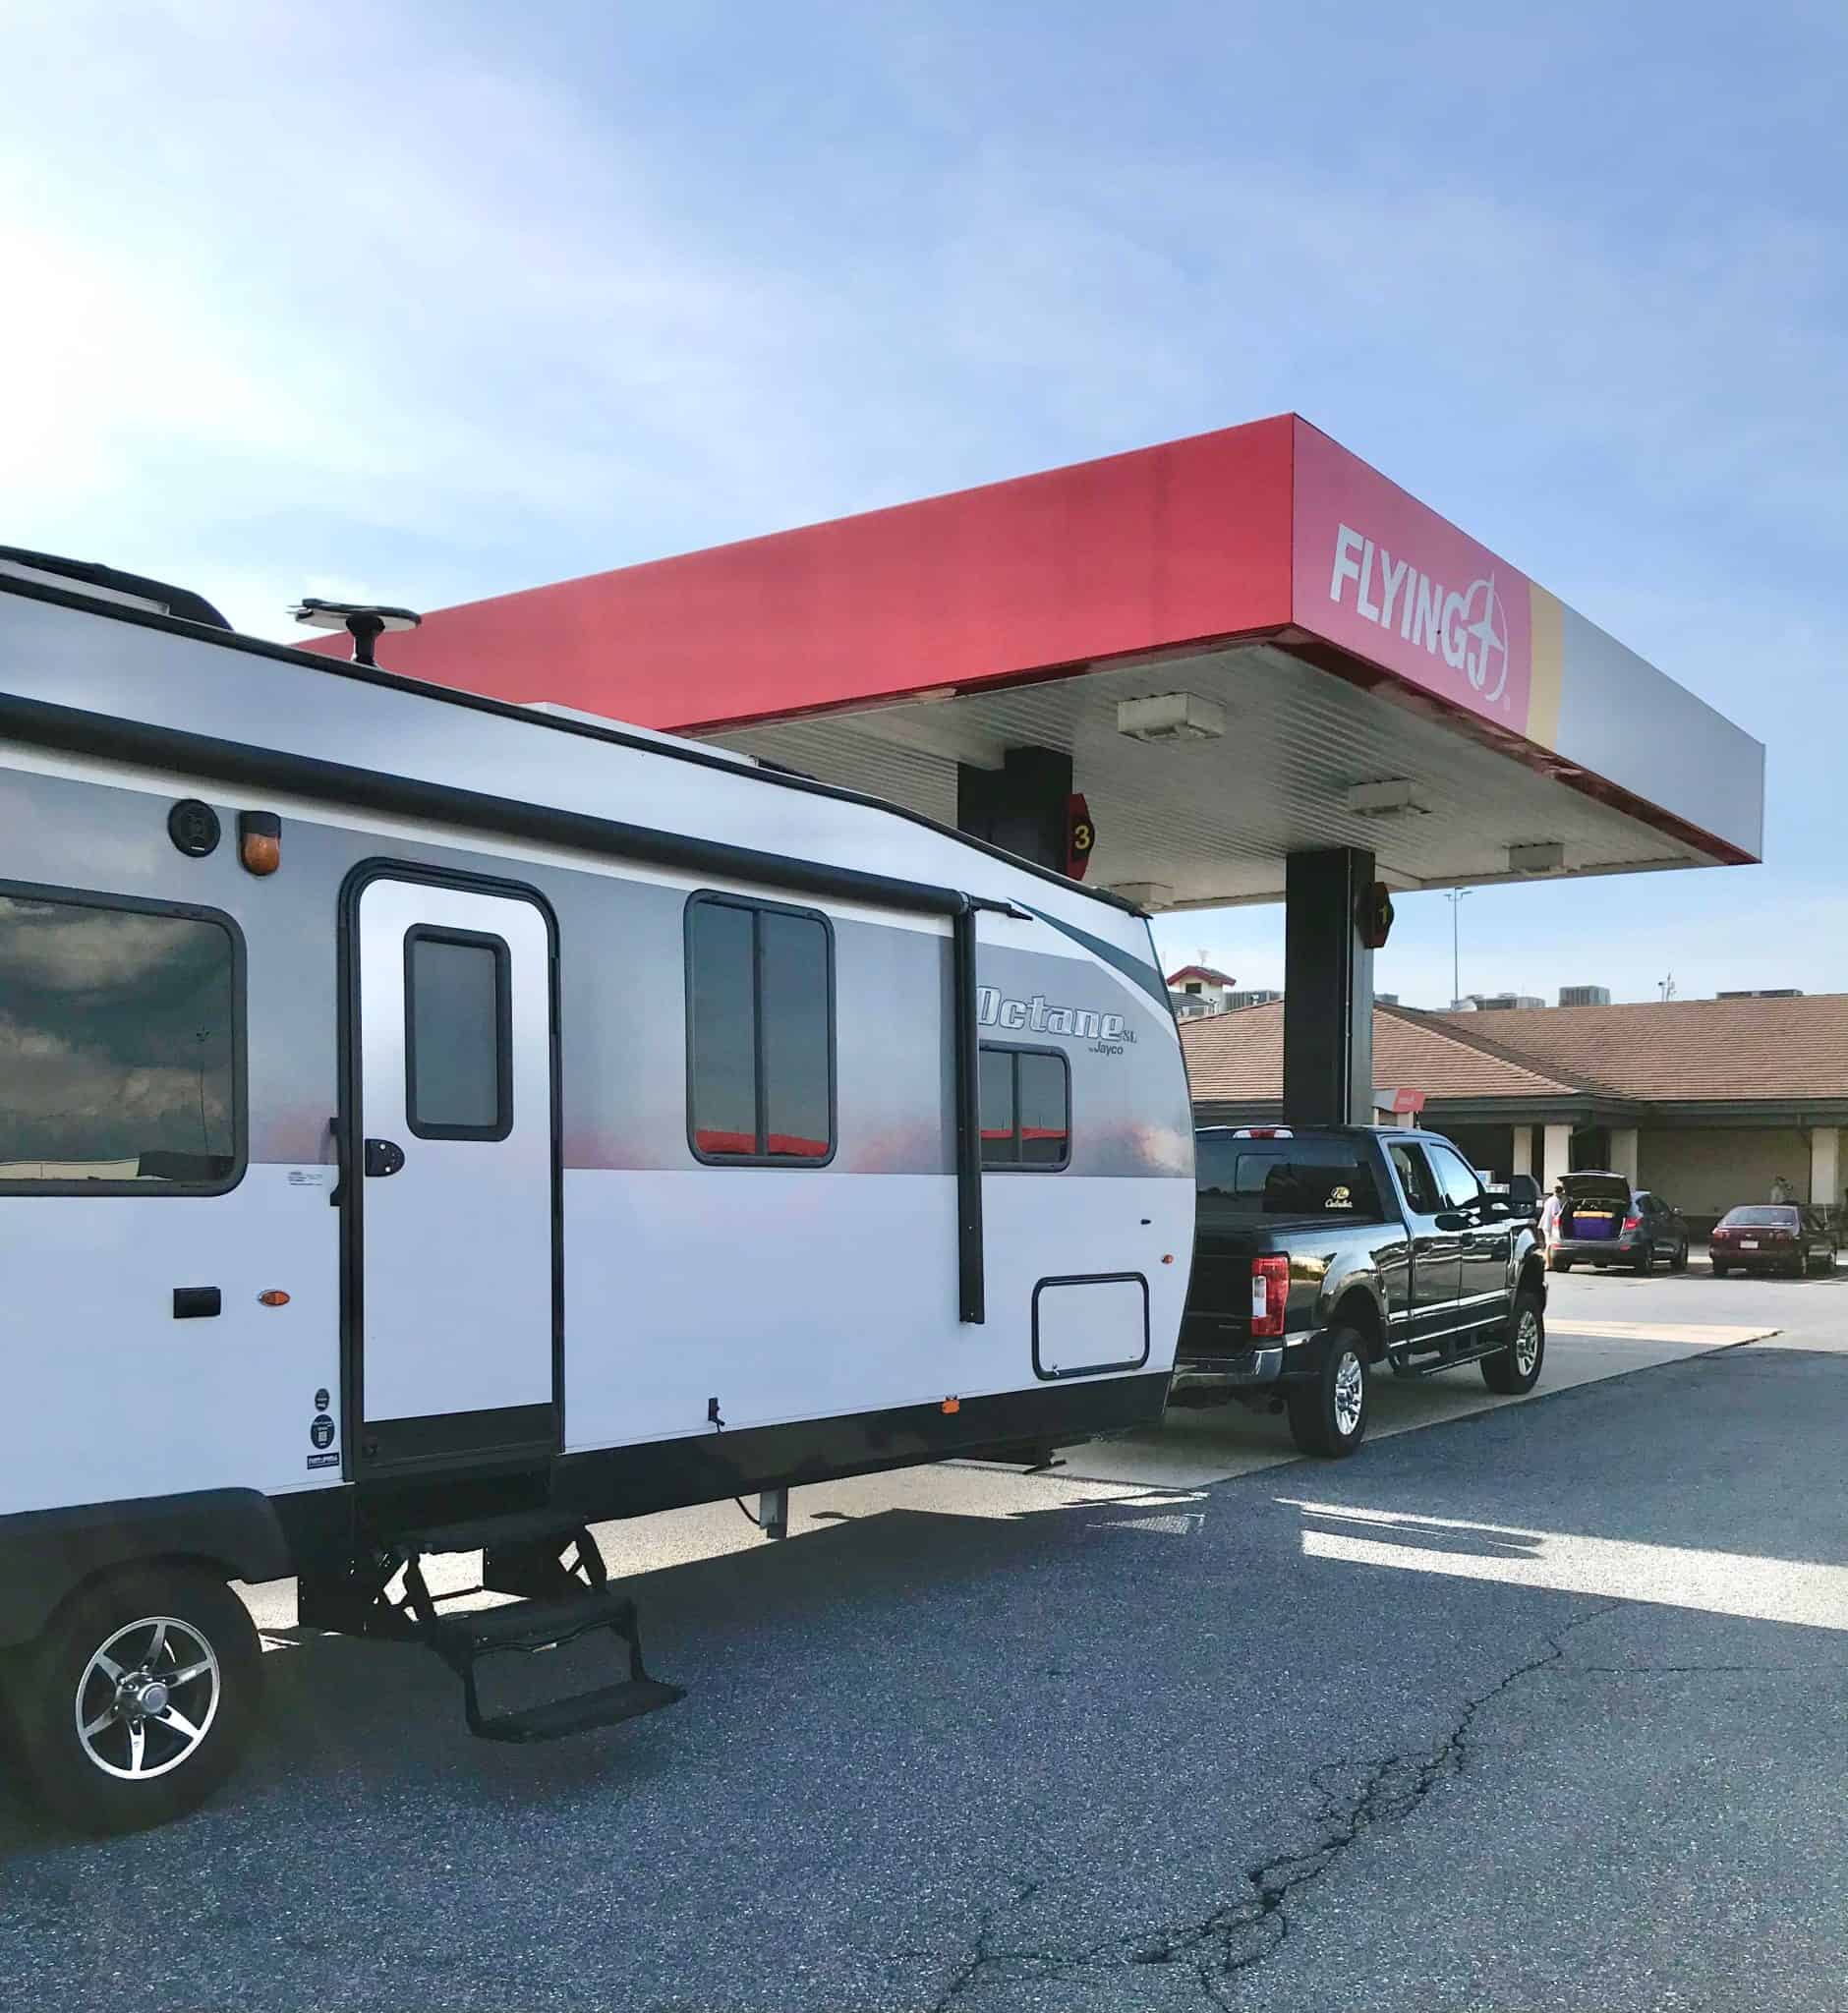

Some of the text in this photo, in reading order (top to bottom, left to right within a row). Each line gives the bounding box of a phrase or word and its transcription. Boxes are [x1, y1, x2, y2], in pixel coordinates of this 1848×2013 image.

[1330, 523, 1470, 669] FLYING
[1074, 825, 1090, 850] 3
[977, 985, 1126, 1042] Octane
[1093, 1040, 1124, 1057] Jayco
